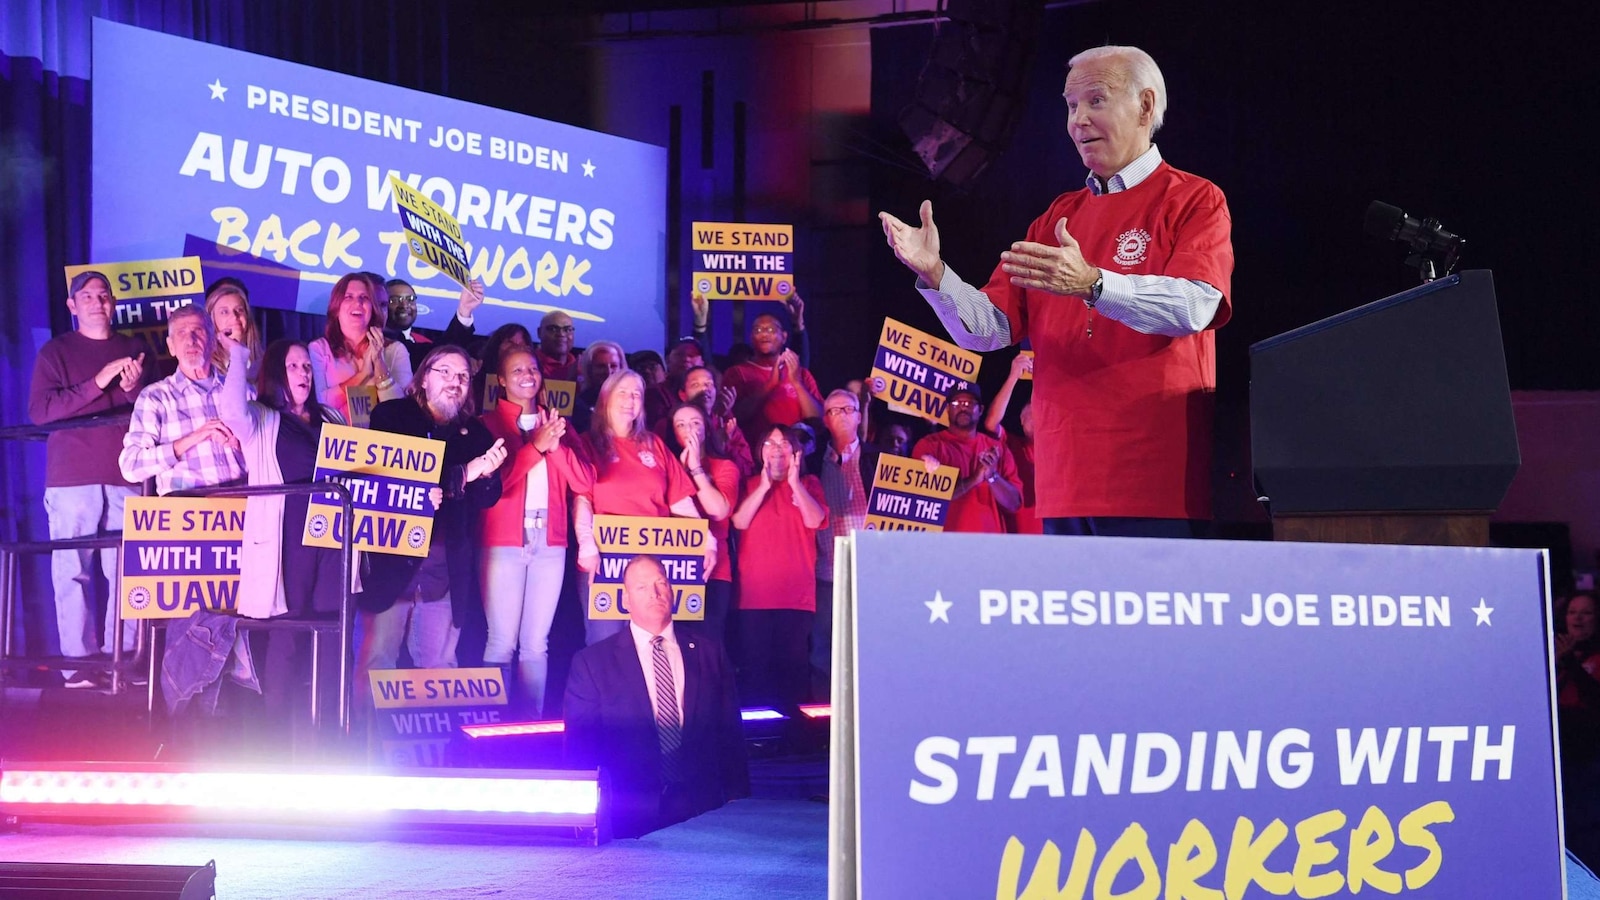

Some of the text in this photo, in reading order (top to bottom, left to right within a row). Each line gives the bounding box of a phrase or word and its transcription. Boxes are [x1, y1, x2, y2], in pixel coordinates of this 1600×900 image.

[247, 84, 569, 174] PRESIDENT JOE BIDEN
[179, 131, 352, 205] AUTO
[395, 184, 461, 239] WE STAND
[210, 206, 364, 269] BACK
[465, 240, 594, 298] WORK
[405, 211, 467, 265] WITH THE
[698, 231, 789, 247] WE STAND
[423, 241, 466, 286] UAW
[702, 253, 785, 271] WITH THE
[117, 268, 196, 292] STAND
[715, 276, 774, 296] UAW
[109, 303, 143, 325] TH
[886, 326, 975, 375] WE STAND
[884, 351, 956, 392] WITH TH
[351, 395, 372, 416] WE
[889, 379, 950, 419] UAW
[324, 436, 437, 473] WE STAND
[880, 463, 952, 493] WE STAND
[387, 483, 426, 511] THE
[876, 492, 942, 521] WITH THE
[132, 509, 246, 531] WE STAN
[599, 526, 704, 548] WE STAND
[138, 546, 243, 571] WITH TH
[661, 559, 697, 580] THE
[156, 580, 240, 612] UAW
[979, 589, 1451, 627] PRESIDENT JOE BIDEN
[377, 678, 501, 700] WE STAND
[391, 712, 452, 735] WITH
[909, 724, 1516, 805] STANDING WITH
[995, 800, 1456, 900] WORKERS
